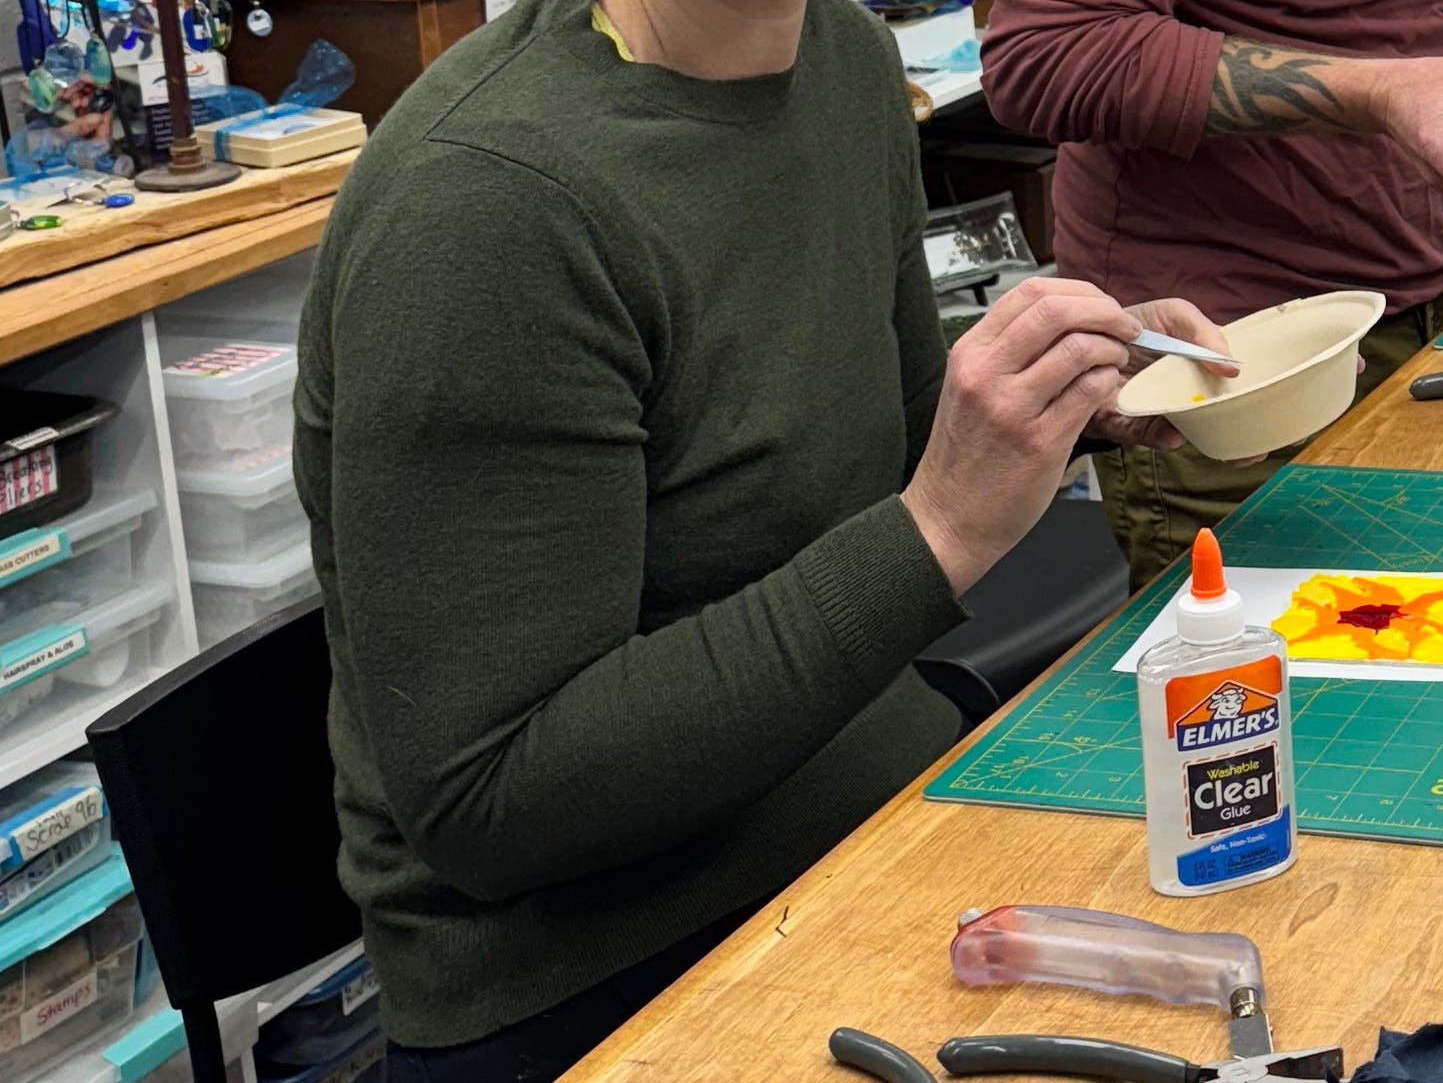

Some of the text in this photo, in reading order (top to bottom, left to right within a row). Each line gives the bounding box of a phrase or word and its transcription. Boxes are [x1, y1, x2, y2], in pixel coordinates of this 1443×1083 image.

[3, 653, 46, 680] HAIRSPRAY
[54, 639, 75, 654] ALOE
[1182, 707, 1279, 747] ELMER'S
[1206, 760, 1260, 781] Washable
[1194, 771, 1274, 810] Clear
[1220, 804, 1252, 821] Glue
[26, 814, 72, 852] Scrap
[1210, 832, 1266, 854] Safe, Non-Toxic
[36, 983, 92, 1026] Stamps
